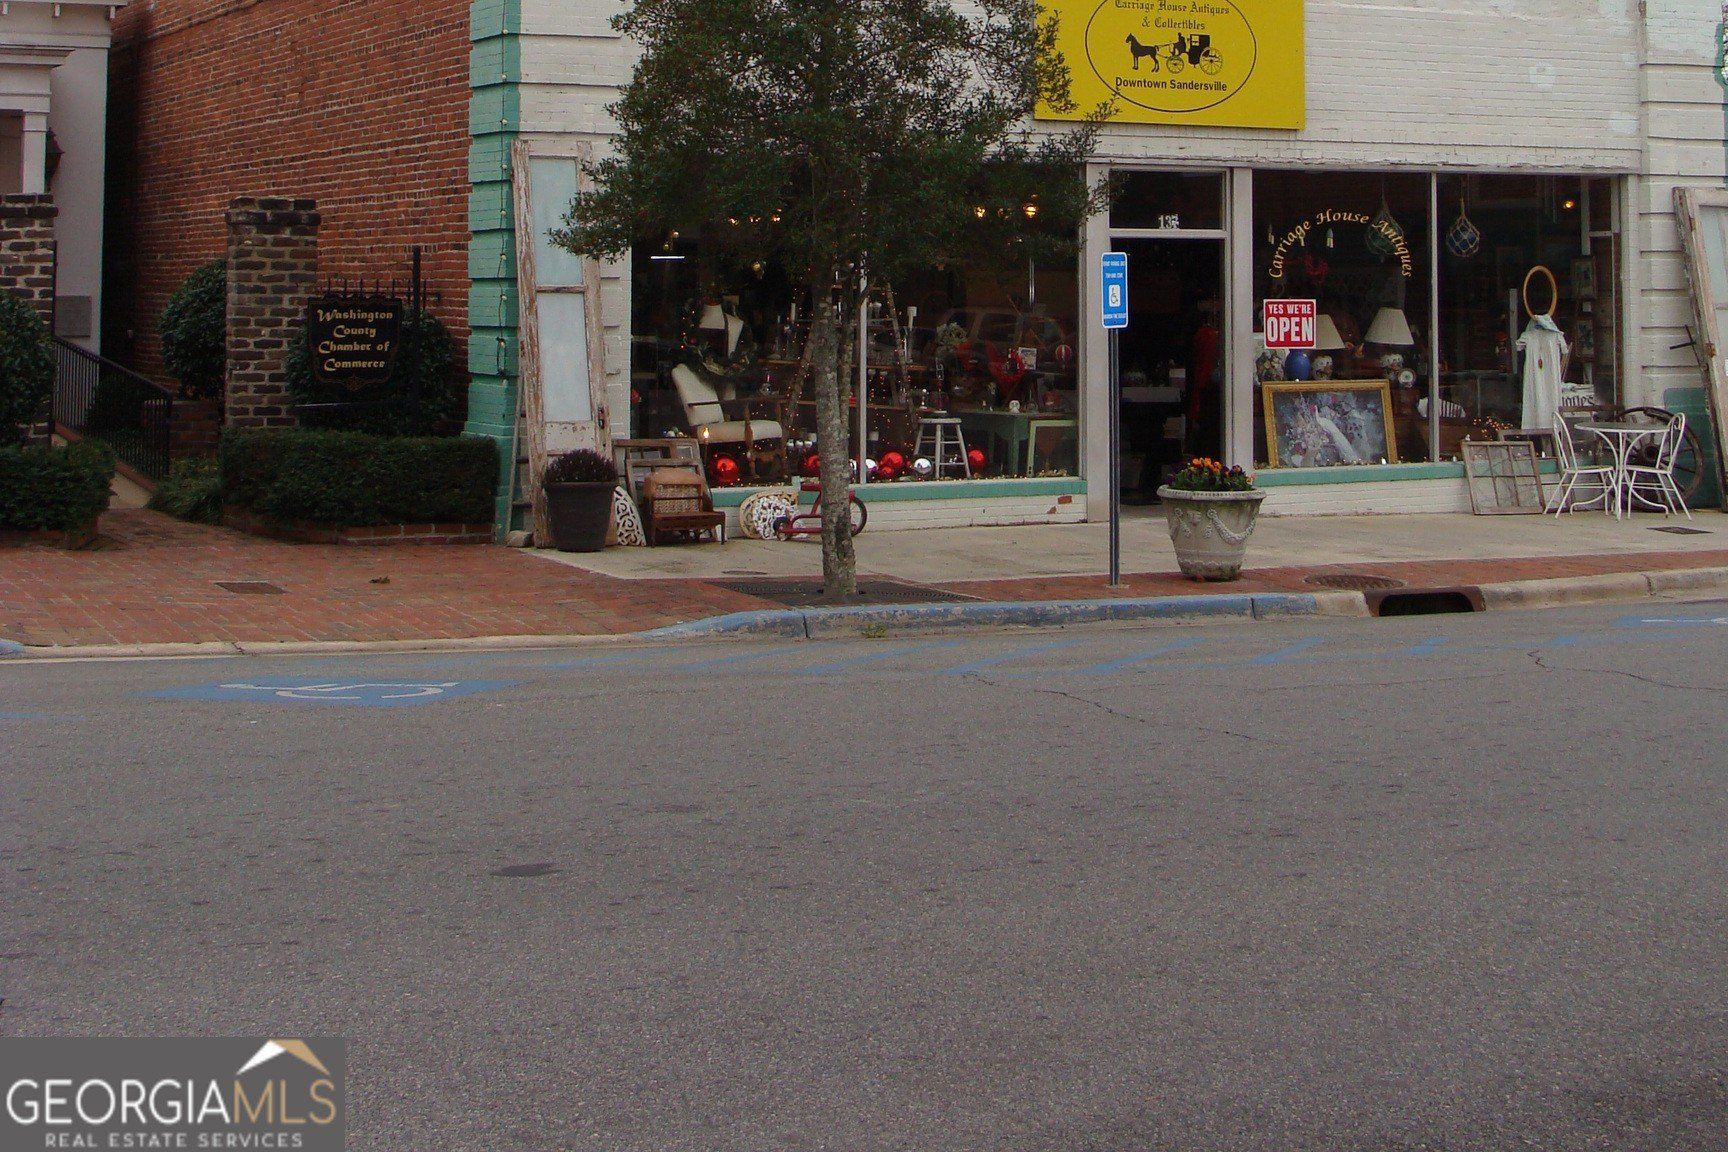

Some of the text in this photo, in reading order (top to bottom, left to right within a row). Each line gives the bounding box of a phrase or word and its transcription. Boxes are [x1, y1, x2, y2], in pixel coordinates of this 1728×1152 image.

[1189, 1, 1230, 16] Antiques
[1141, 16, 1206, 30] & Collectibles
[1115, 76, 1228, 92] Downtown Sandersville
[1268, 208, 1413, 279] Carriage House Antiques
[316, 309, 394, 323] Washington
[1268, 303, 1312, 315] YES WE'RE
[333, 324, 377, 338] County
[1266, 316, 1313, 343] OPEN
[318, 340, 390, 354] Chamber of
[324, 358, 386, 372] Commerce
